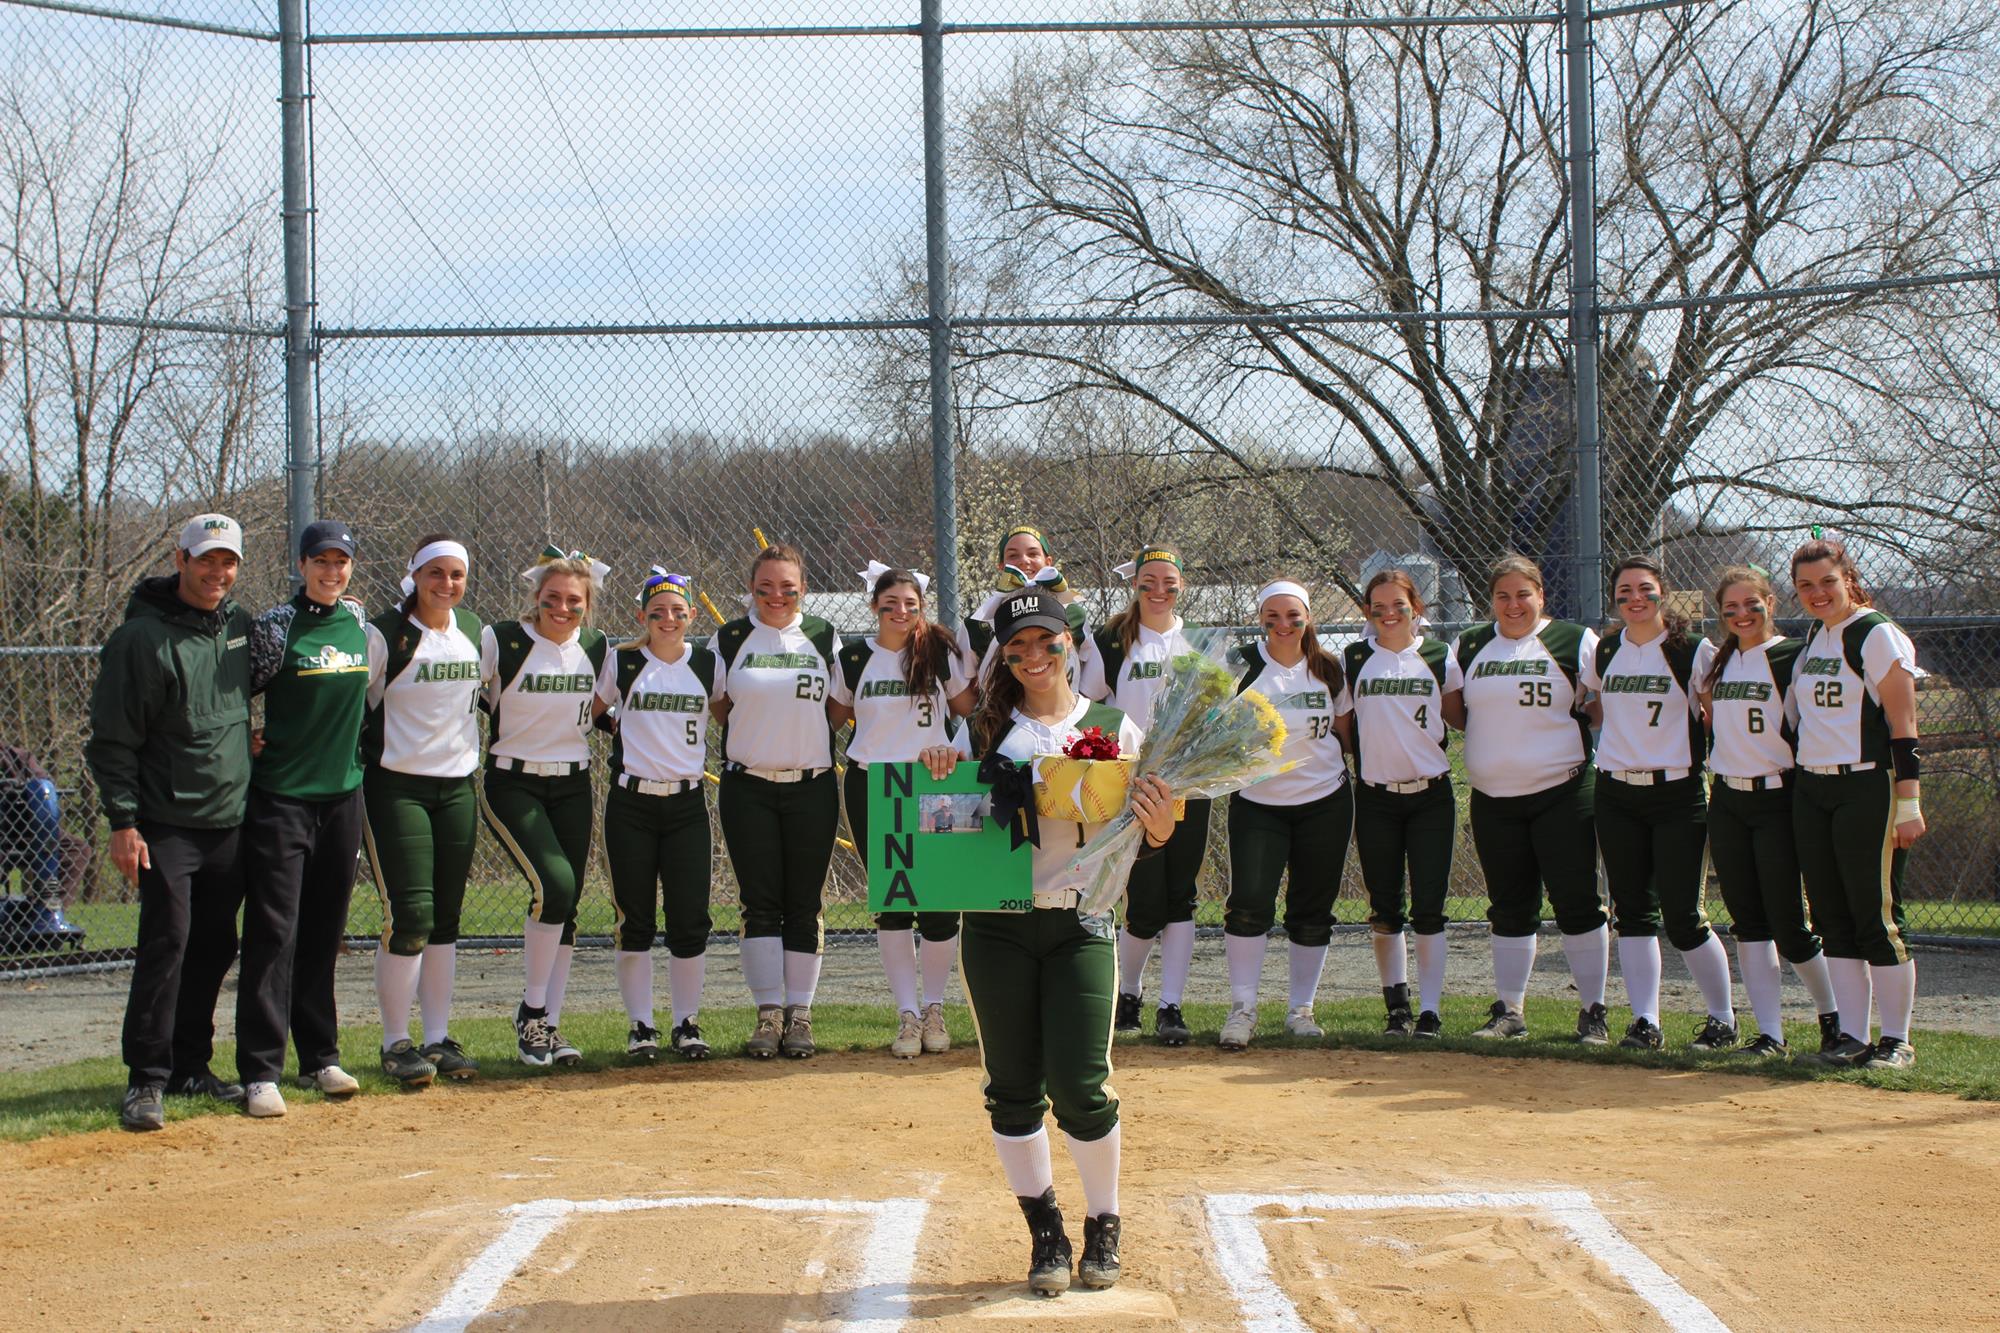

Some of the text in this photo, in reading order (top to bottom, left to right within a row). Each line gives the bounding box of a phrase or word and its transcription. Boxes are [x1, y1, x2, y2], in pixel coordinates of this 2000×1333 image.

[1144, 551, 1175, 563] AGGIES
[650, 582, 685, 597] AGGIES
[1011, 597, 1039, 612] DVU
[1012, 607, 1040, 618] SOFTBALL
[739, 652, 819, 670] AGGIES
[1471, 660, 1549, 680] AGGIES
[518, 674, 594, 693] AGGIES
[795, 673, 825, 702] 23
[1358, 678, 1434, 698] AGGIES
[1519, 682, 1552, 707] 35
[1602, 674, 1671, 694] AGGIES
[1712, 681, 1773, 702] GGIES
[1815, 681, 1844, 707] 22
[577, 699, 592, 727] 14
[628, 691, 706, 714] AGGIES
[1647, 701, 1664, 727] 7
[917, 702, 932, 728] 3
[1414, 704, 1428, 729] 4
[1748, 707, 1764, 734] 6
[687, 719, 698, 745] 5
[1307, 715, 1331, 740] 33
[883, 763, 919, 907] NINA
[999, 898, 1033, 911] 2018
